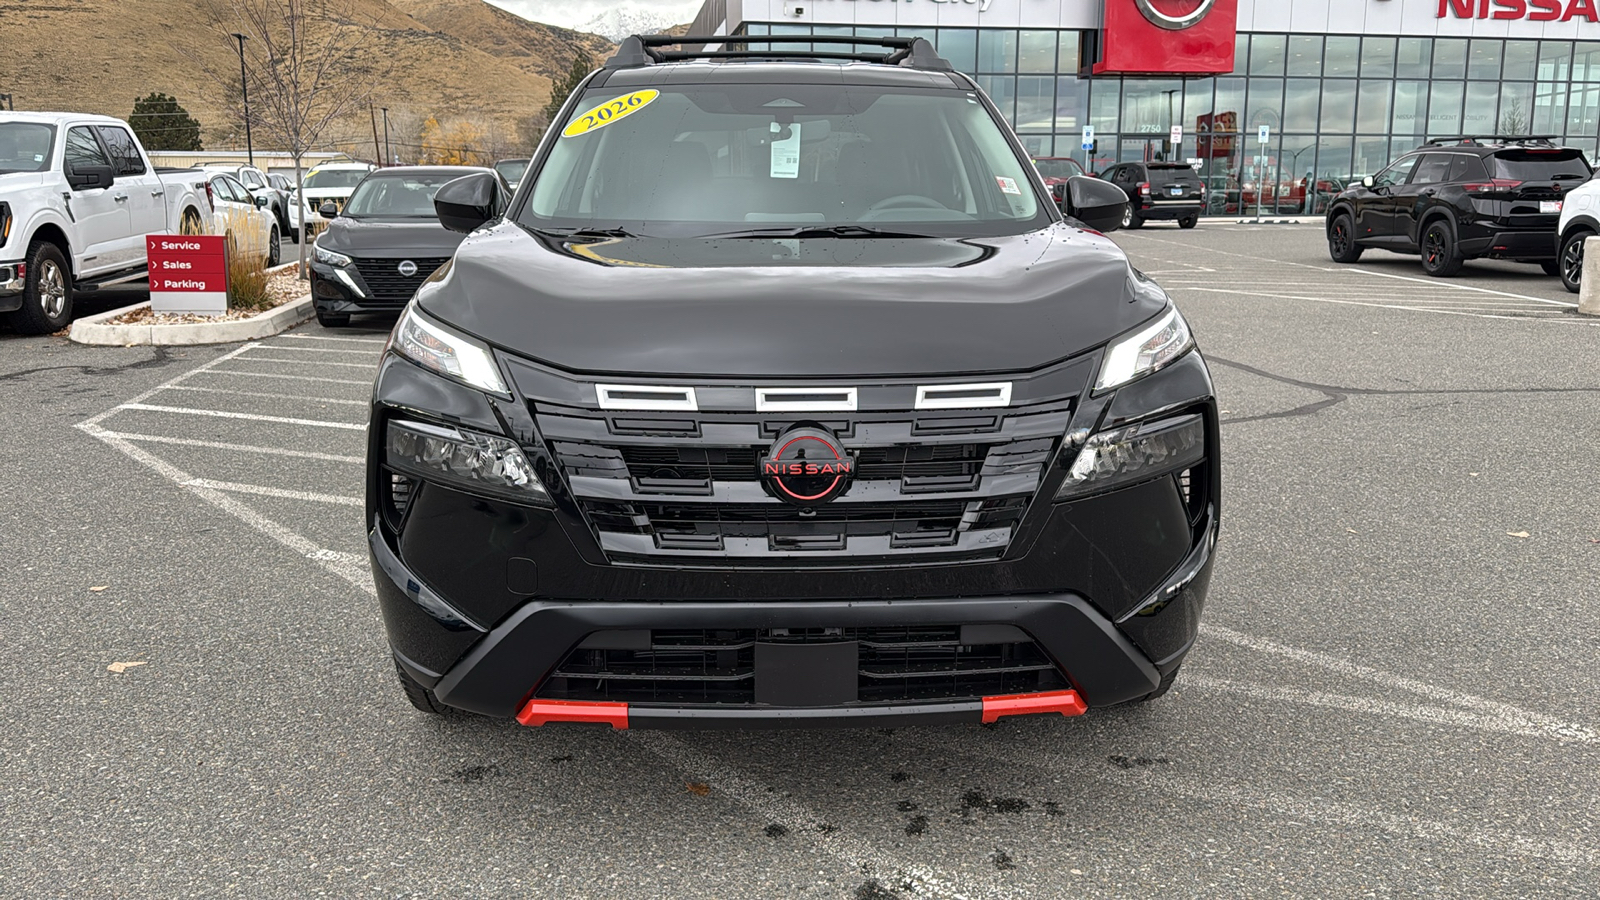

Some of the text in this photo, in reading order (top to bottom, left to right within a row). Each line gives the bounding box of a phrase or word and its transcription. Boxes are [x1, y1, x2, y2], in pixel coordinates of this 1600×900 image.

[1436, 0, 1600, 22] NISSA
[581, 93, 642, 129] 2026
[1141, 125, 1161, 133] 2750
[161, 241, 201, 250] Service
[162, 260, 192, 269] Sales
[164, 279, 206, 290] Parking
[765, 462, 850, 475] NISSAN
